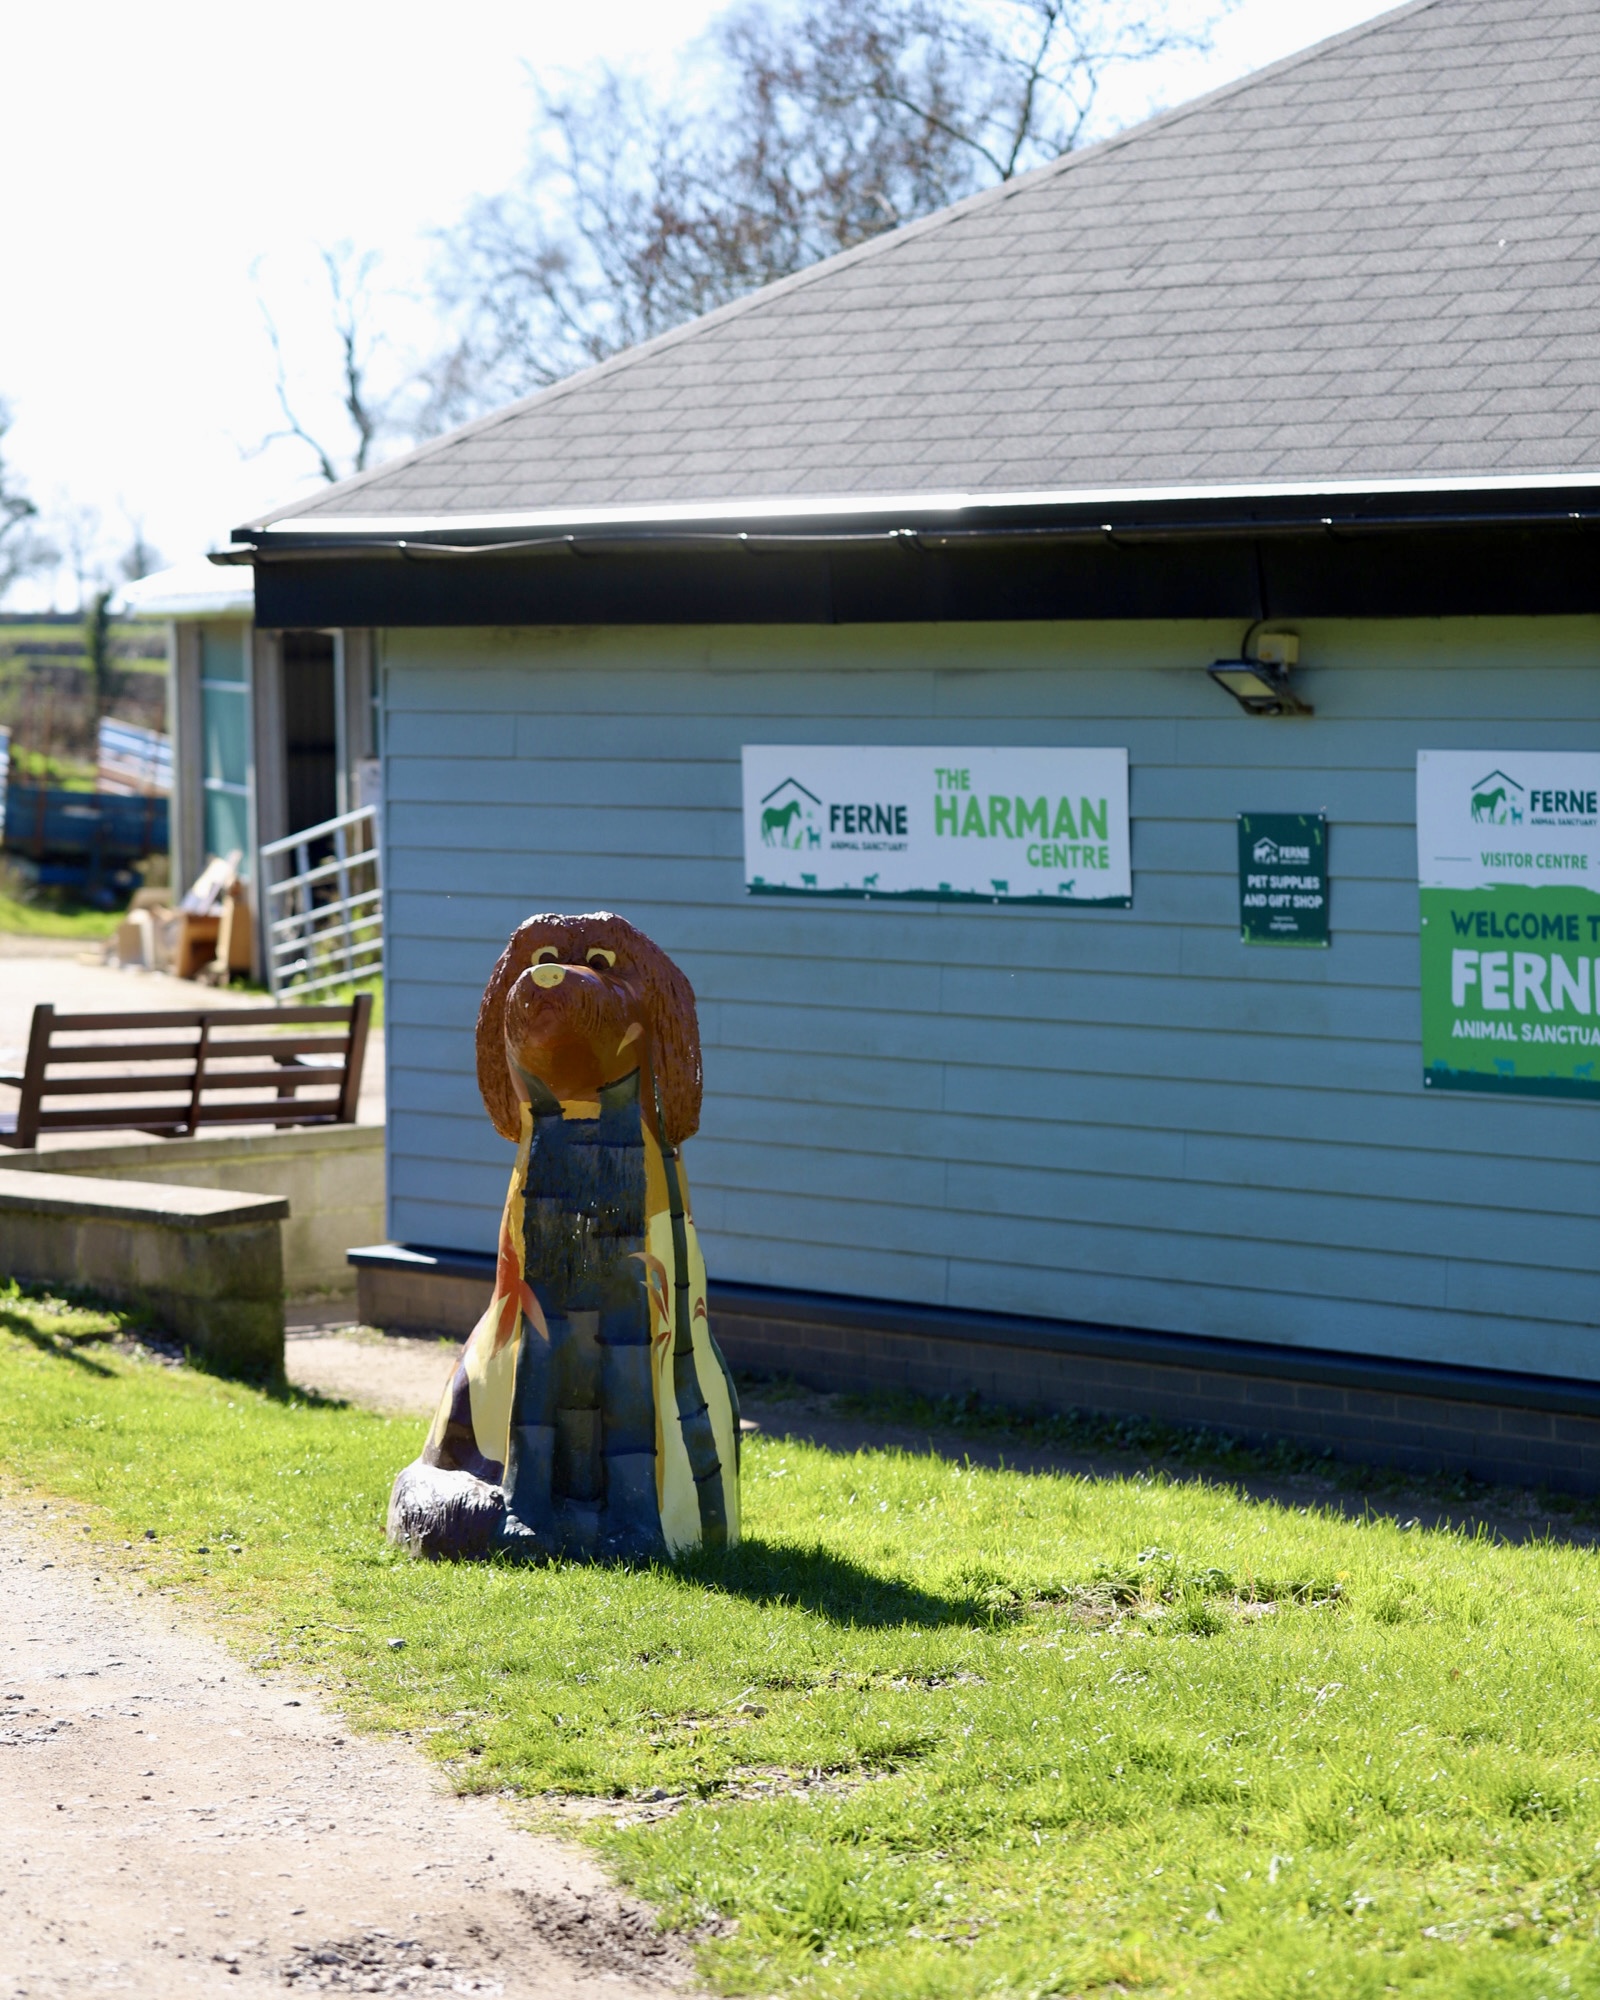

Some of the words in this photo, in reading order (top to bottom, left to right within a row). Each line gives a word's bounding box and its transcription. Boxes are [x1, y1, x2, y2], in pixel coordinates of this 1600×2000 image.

[935, 768, 970, 791] THE
[1530, 789, 1597, 814] FERNE
[830, 802, 908, 836] FERNE
[934, 794, 1108, 841] HARMAN
[1531, 817, 1556, 826] ANIMAL
[1558, 818, 1597, 827] SANCTUARY
[830, 841, 860, 851] ANIMAL
[862, 841, 907, 852] SANCTUARY
[1026, 843, 1109, 869] CENTRE
[1480, 852, 1533, 868] VISITOR
[1535, 853, 1588, 870] CENTRE
[1247, 874, 1268, 889] PET
[1269, 875, 1320, 890] SUPPLIES
[1243, 894, 1268, 907] AND
[1268, 894, 1291, 908] GIFT
[1293, 895, 1323, 909] SHOP
[1450, 909, 1580, 941] WELCOME
[1451, 948, 1600, 1016] FERN
[1451, 1018, 1518, 1042] ANIMAL
